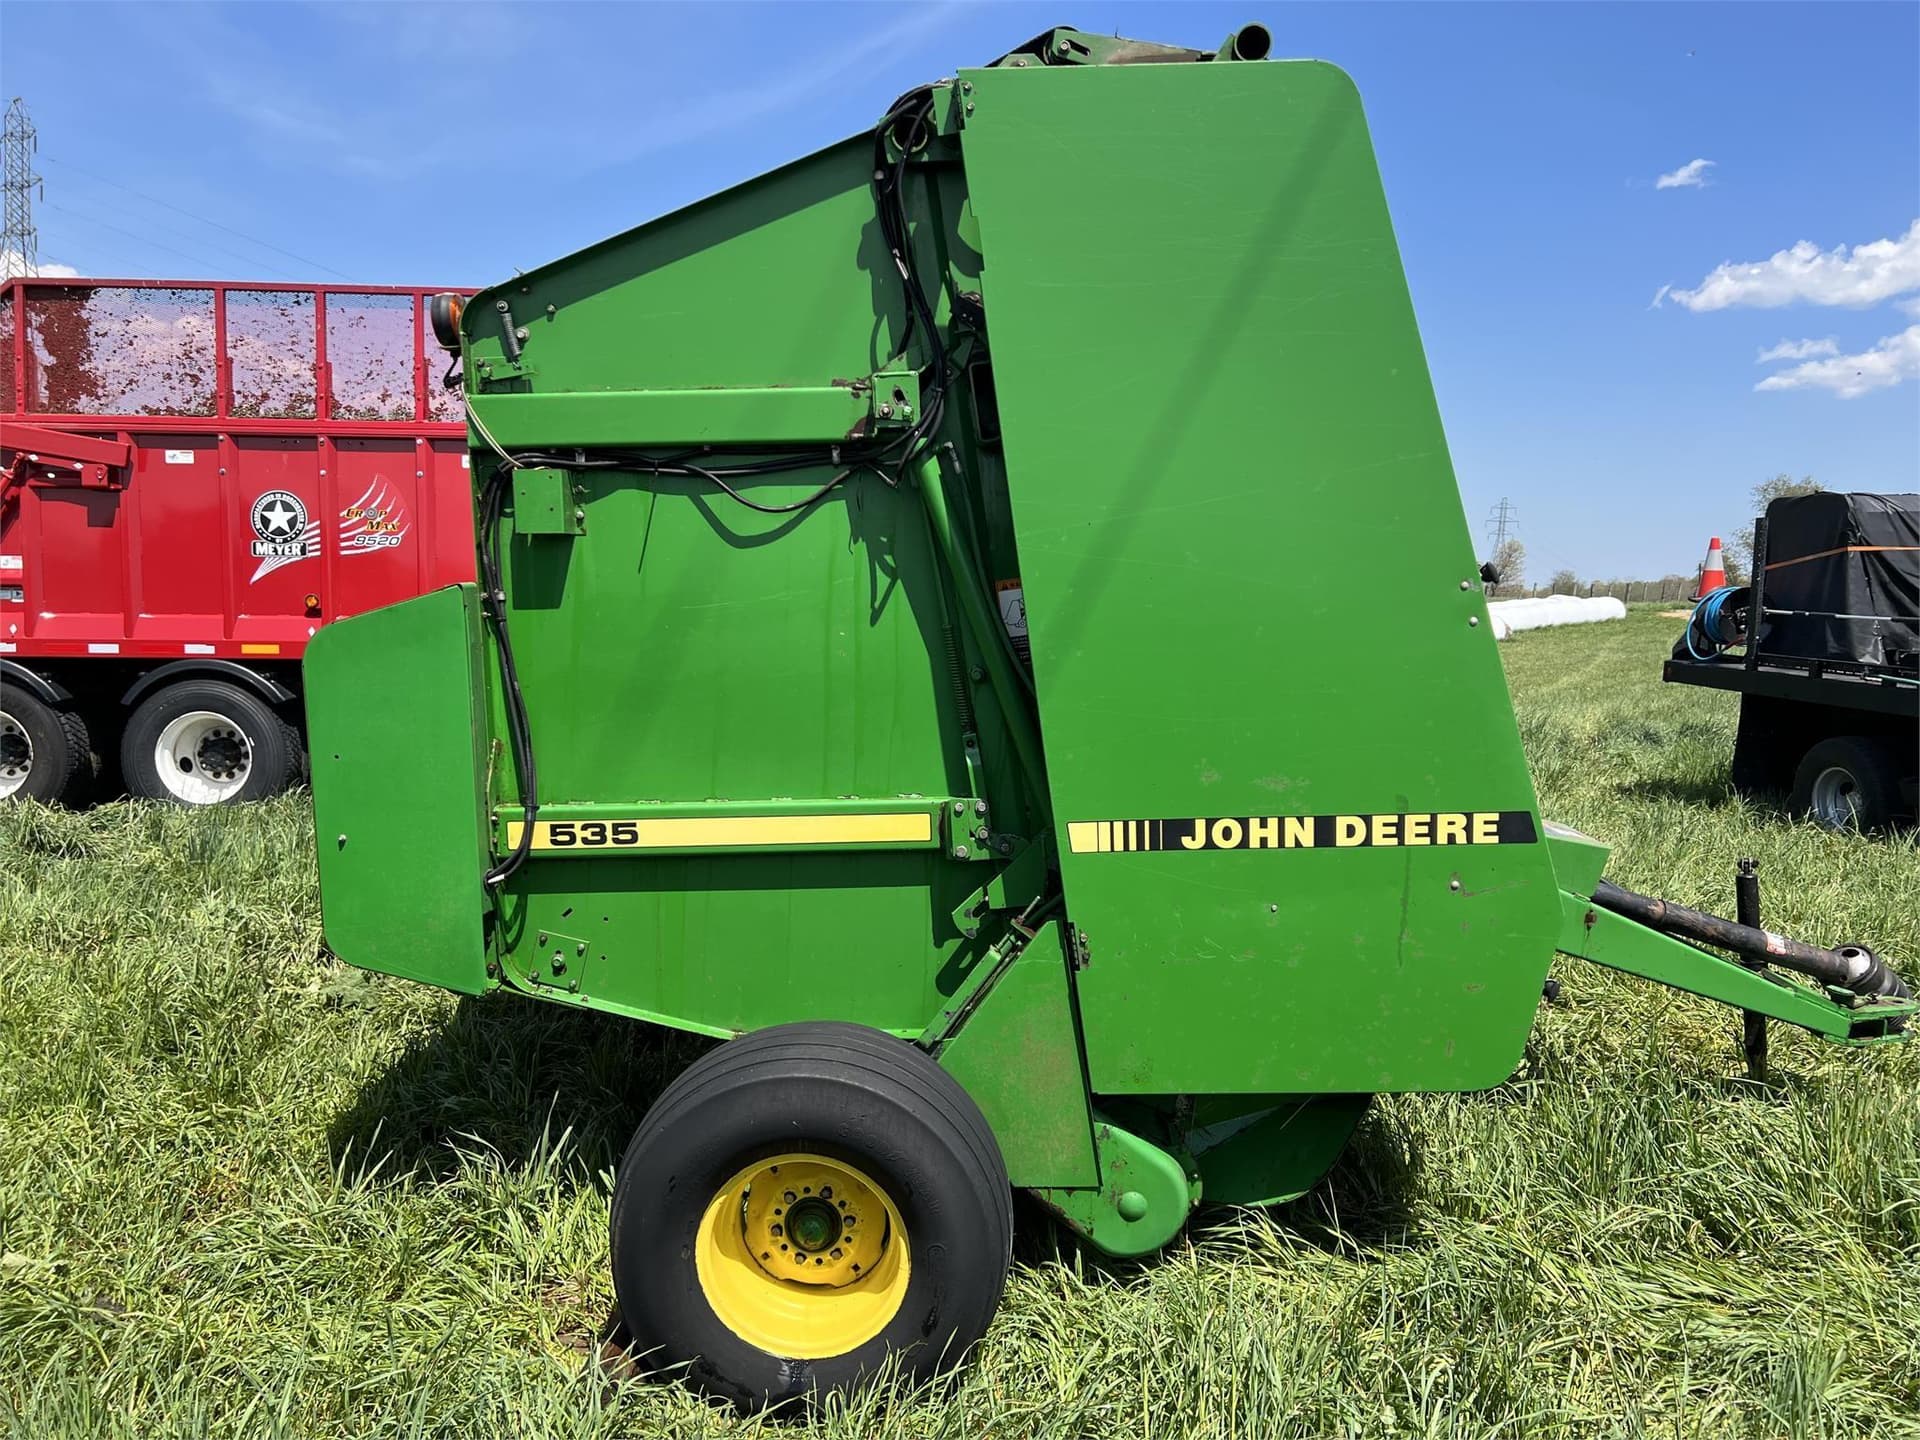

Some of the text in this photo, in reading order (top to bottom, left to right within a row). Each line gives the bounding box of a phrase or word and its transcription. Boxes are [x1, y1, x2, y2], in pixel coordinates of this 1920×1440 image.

[255, 542, 302, 556] MEYER
[354, 535, 401, 546] 9520
[549, 822, 639, 846] 535
[1181, 812, 1501, 850] JOHN DEERE
